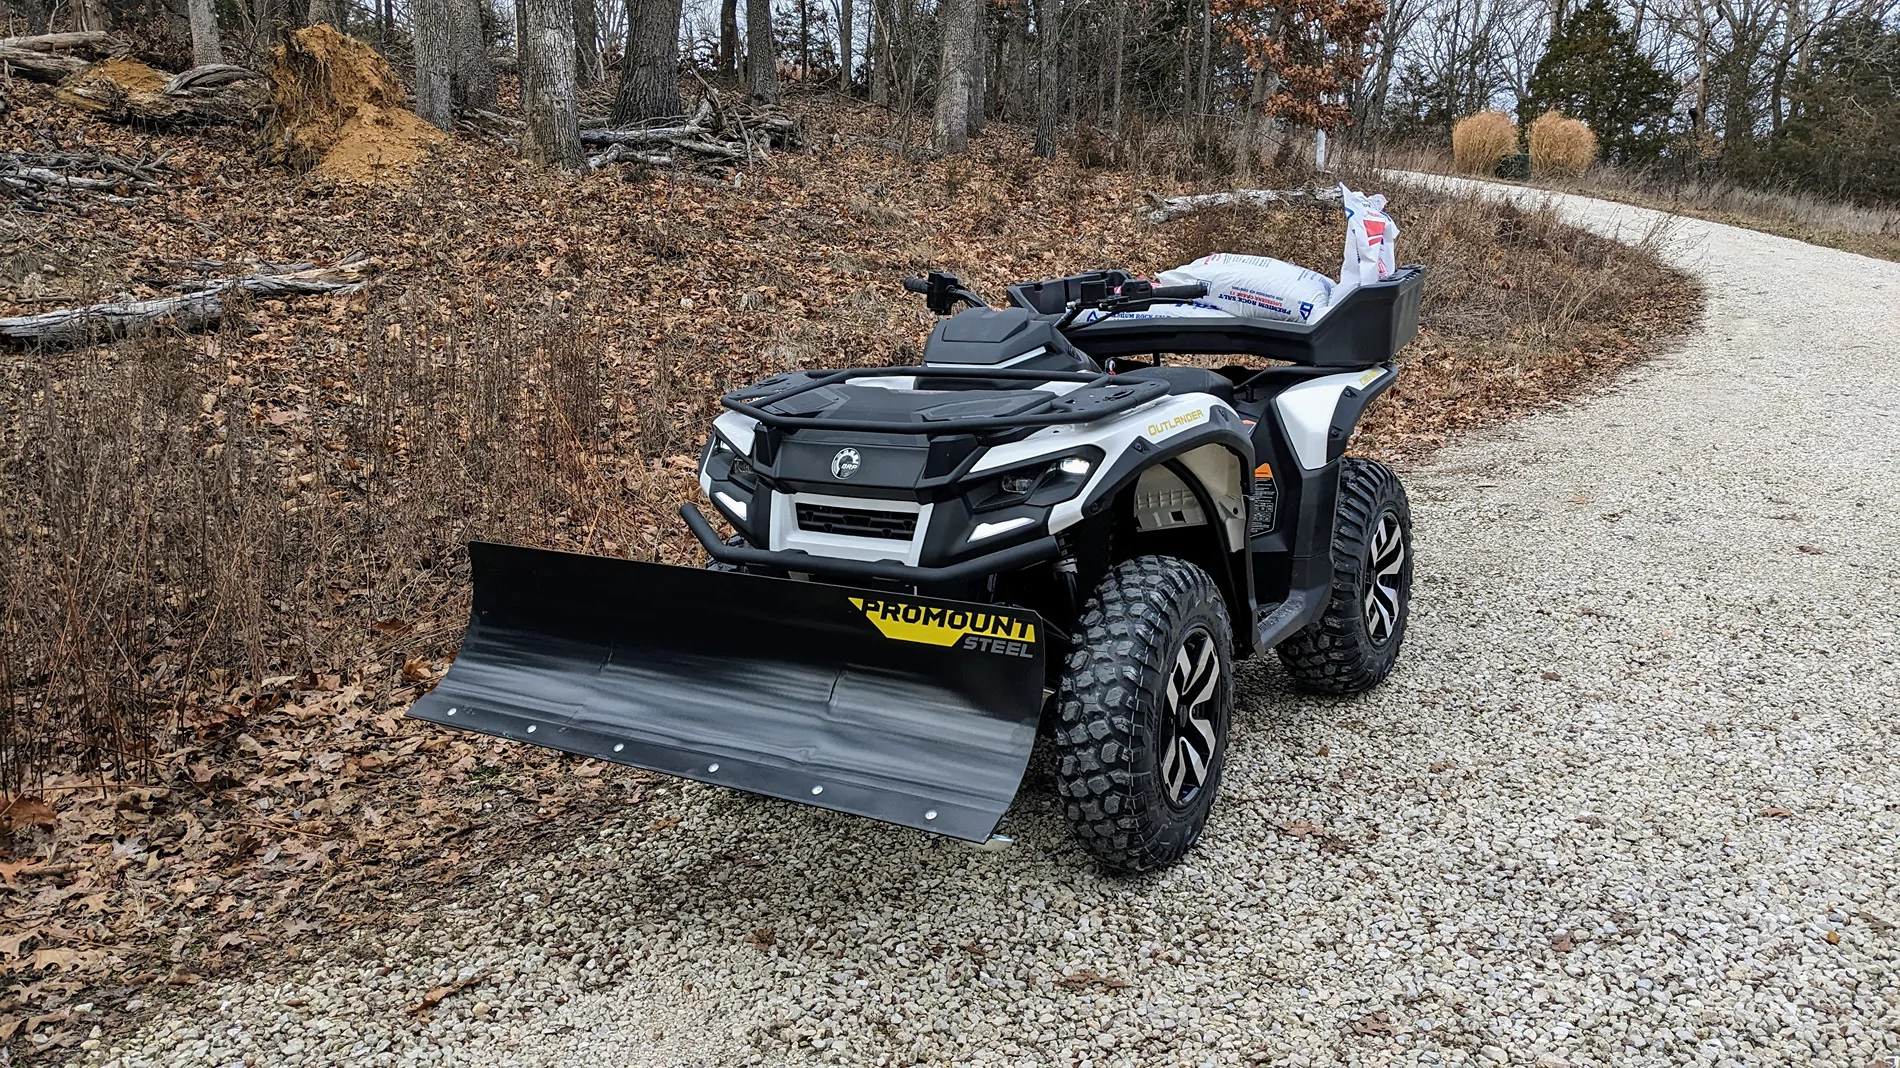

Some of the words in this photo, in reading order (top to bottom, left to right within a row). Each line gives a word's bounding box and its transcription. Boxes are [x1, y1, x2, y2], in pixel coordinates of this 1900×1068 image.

[1218, 293, 1237, 302] SALT
[1237, 296, 1257, 306] ROCK
[1258, 302, 1292, 315] PREMIUM
[1148, 409, 1204, 437] OUTLANDER
[862, 600, 1034, 639] PROMOUNT
[963, 635, 1034, 659] STEEL
